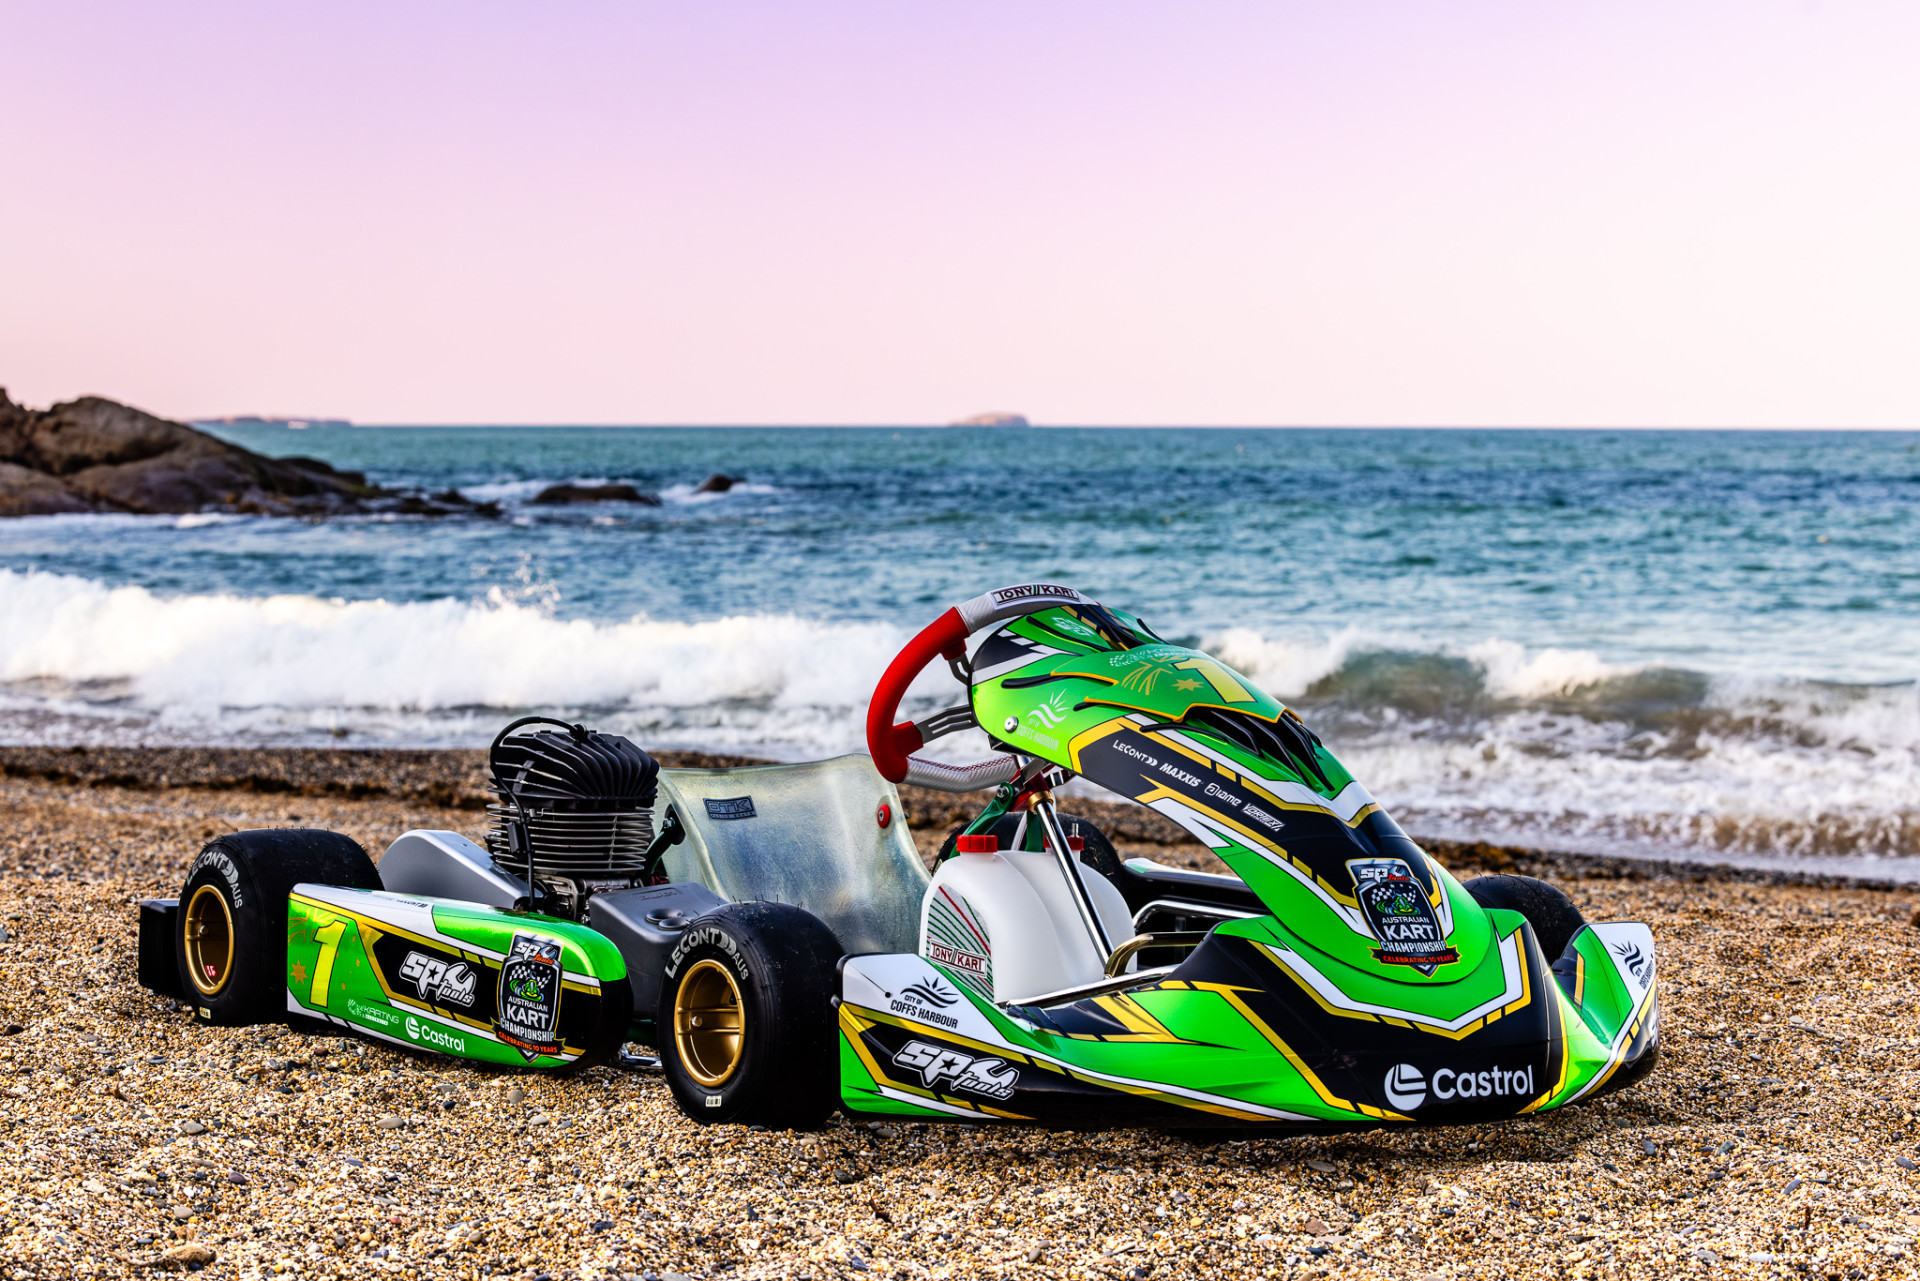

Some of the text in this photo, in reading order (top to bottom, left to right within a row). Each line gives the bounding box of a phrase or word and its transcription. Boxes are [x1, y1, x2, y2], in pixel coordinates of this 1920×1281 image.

[996, 585, 1033, 600] TONY
[1171, 657, 1258, 704] 1
[1159, 762, 1202, 787] MAXXIS
[707, 799, 751, 813] OTK
[1360, 867, 1389, 884] SP
[230, 882, 243, 909] AUS
[1382, 916, 1430, 924] AUSTRALIAN
[1383, 924, 1435, 940] KART
[514, 942, 541, 963] SP
[664, 927, 720, 979] LECONT
[931, 942, 985, 971] TONY KART
[1380, 940, 1447, 953] CHAMPIONSHIP
[1382, 955, 1429, 964] CELEBRATING
[1436, 954, 1455, 962] YEARS
[309, 919, 348, 1009] 1
[401, 951, 449, 999] SP
[731, 952, 749, 980] AUS
[437, 980, 474, 1006] tools
[508, 995, 549, 1012] AUSTRALIAN
[904, 994, 915, 1003] CITY
[363, 1006, 400, 1025] KARTING
[507, 1004, 549, 1030] KART
[890, 999, 958, 1029] COFFS HARBOUR
[421, 1025, 465, 1053] Castrol
[500, 1017, 555, 1042] CHAMPIONSHIP
[498, 1031, 558, 1054] CELEBRATING 10 YEARS
[896, 1041, 974, 1085] SP
[952, 1070, 1014, 1098] tools
[1432, 1064, 1534, 1100] Castrol
